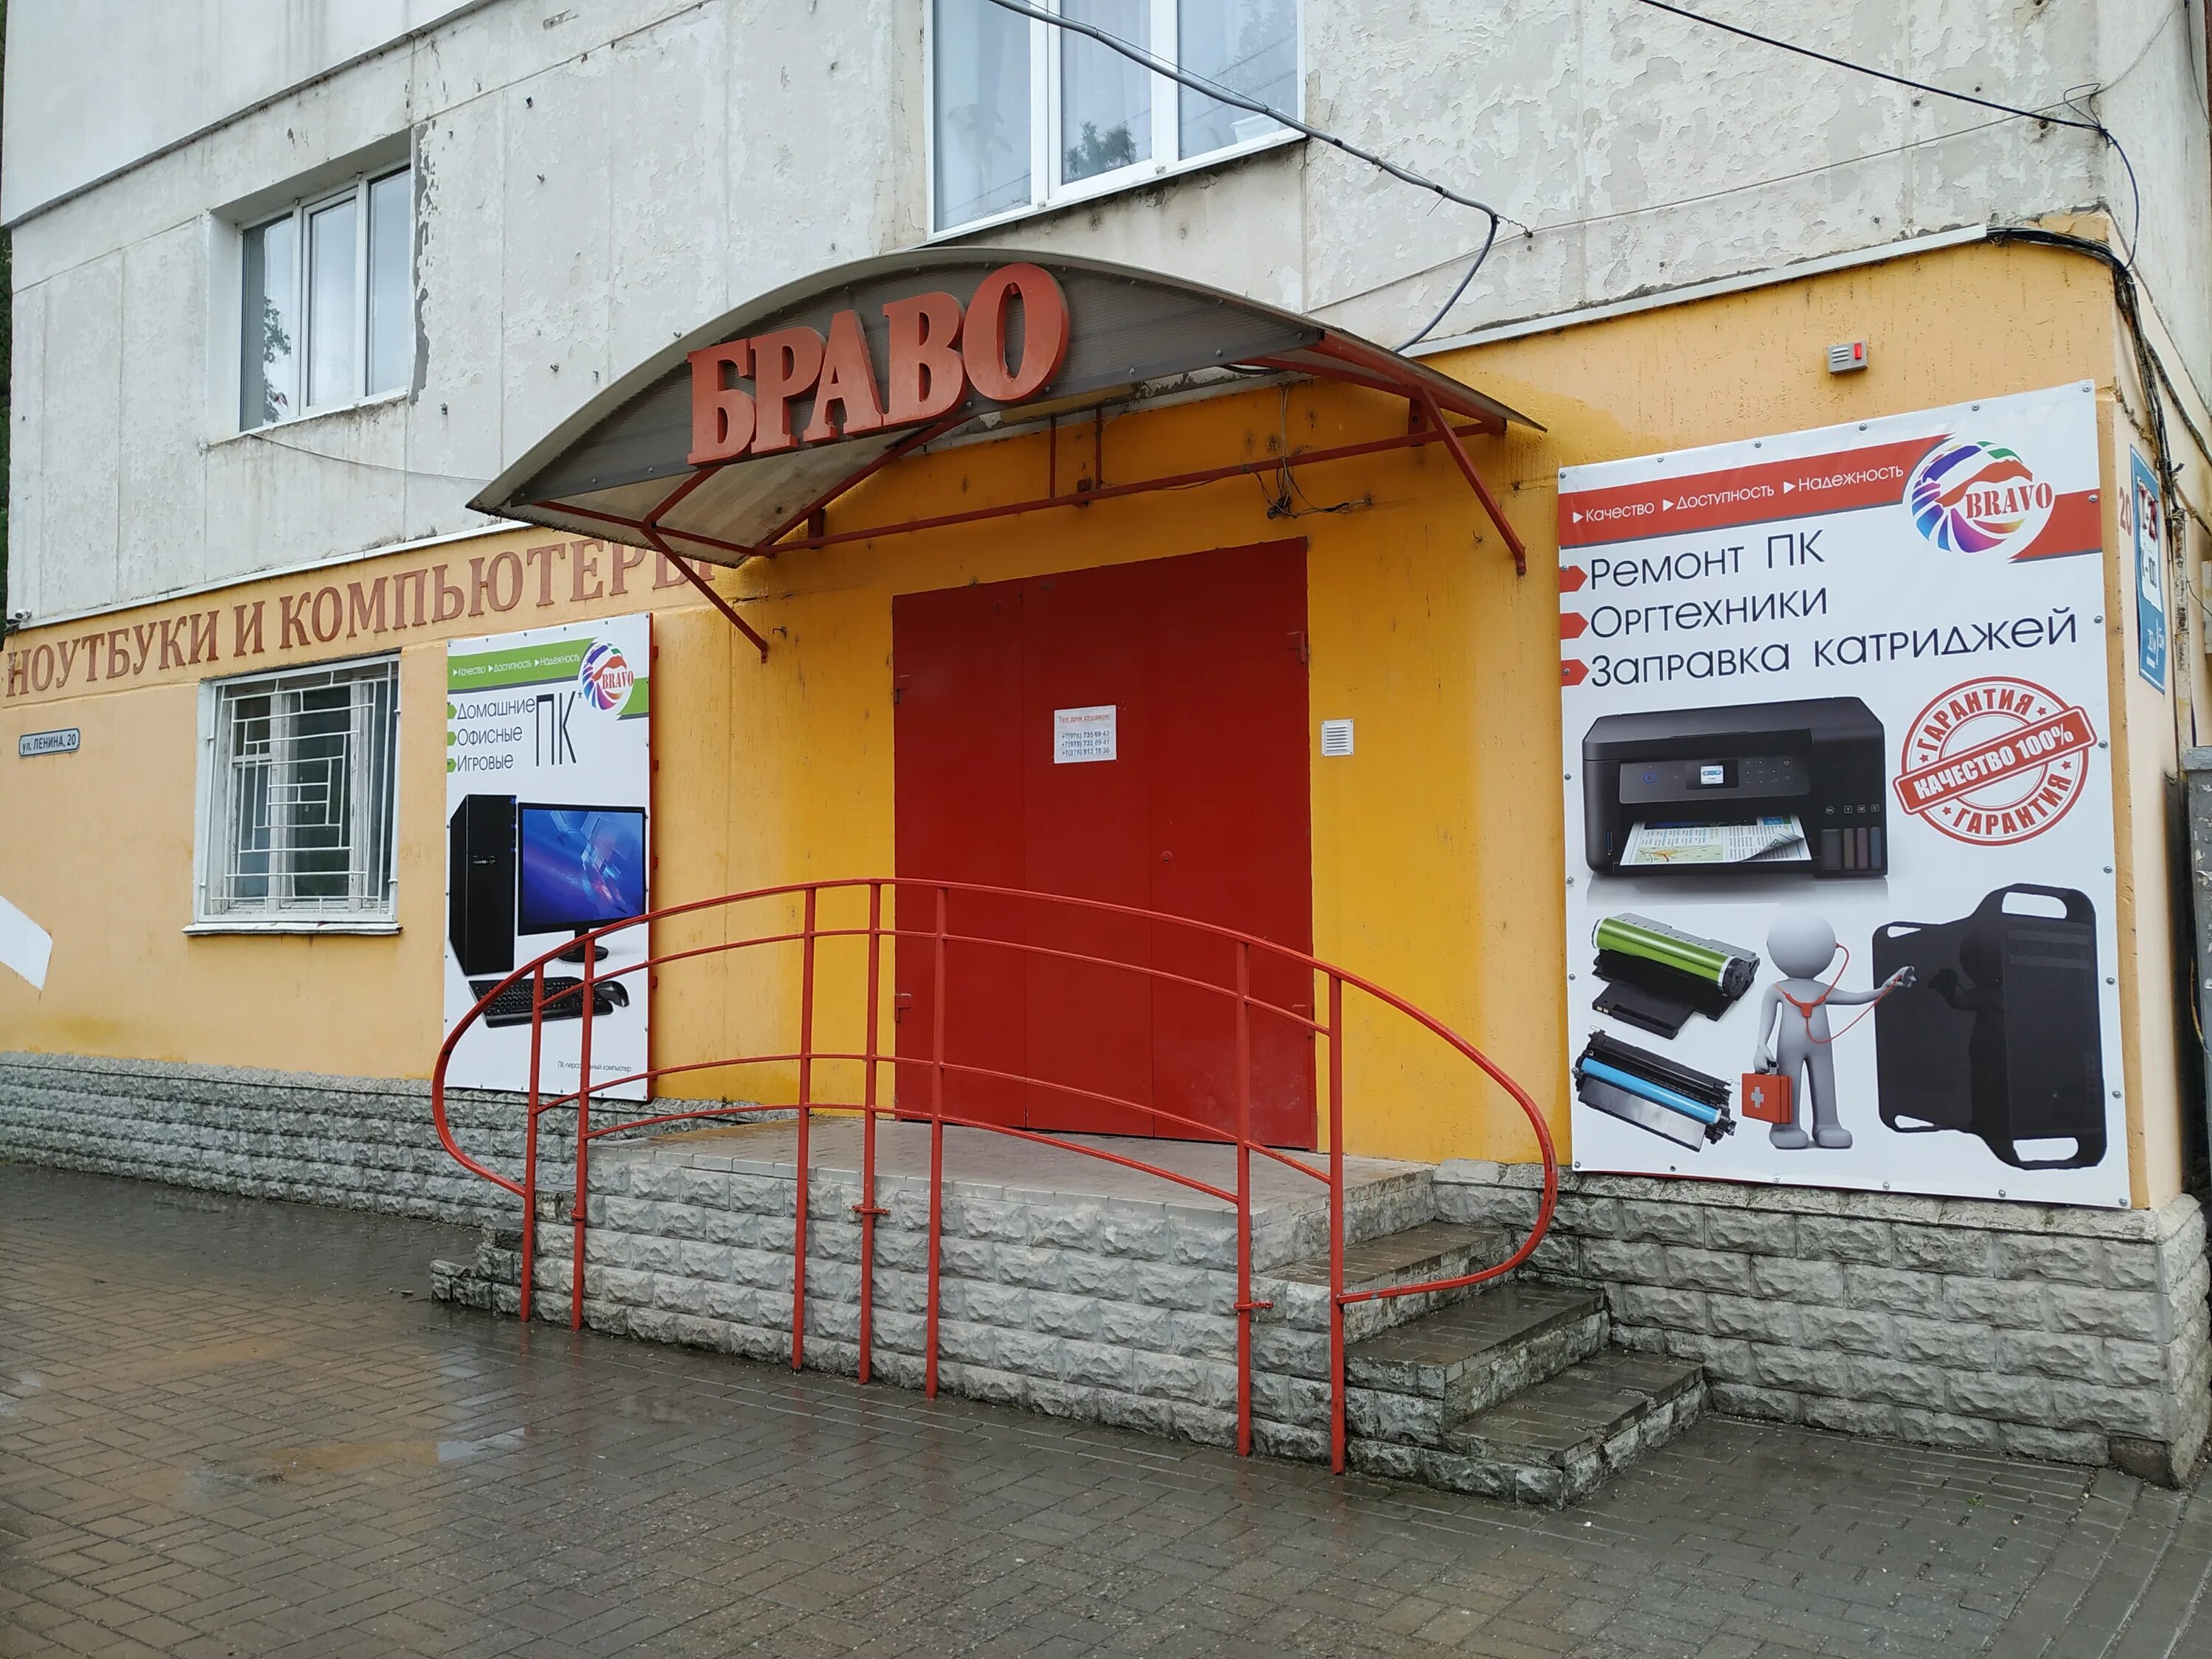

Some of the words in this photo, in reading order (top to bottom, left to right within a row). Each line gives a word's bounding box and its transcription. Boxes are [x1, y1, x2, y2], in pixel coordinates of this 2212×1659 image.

[687, 262, 1069, 466] БРАВО
[1585, 503, 1655, 524] Качество
[1676, 484, 1775, 511] Доступность
[1798, 465, 1905, 492] Надежность
[1964, 482, 2053, 520] BRAVO
[1590, 545, 1745, 590] Ремонт
[1767, 529, 1826, 568] ПК
[1590, 587, 1828, 639] Оргтехники
[7, 609, 220, 697] НОУТБУКИ
[234, 600, 266, 657] И
[457, 666, 486, 677] Качество
[493, 661, 532, 672] Доступность
[540, 654, 581, 667] Надежность
[1590, 641, 1790, 688] Заправка
[1813, 606, 2078, 669] катриджей
[602, 671, 634, 689] BRAVO
[457, 698, 535, 720] Домашние
[1917, 689, 2035, 752] ГАРАНТИЯ
[22, 742, 32, 754] ул.
[33, 735, 66, 751] ЛЕНИНА,
[67, 734, 76, 746] 20
[457, 726, 523, 746] Офисные
[1913, 745, 2017, 800] КАЧЕСТВО
[2015, 723, 2074, 760] 100%
[457, 754, 514, 772] Игровые
[1952, 773, 2073, 835] ГАРАНТИЯ
[557, 1061, 602, 1071] ПК-персоьный
[602, 1065, 632, 1074] компьютер
